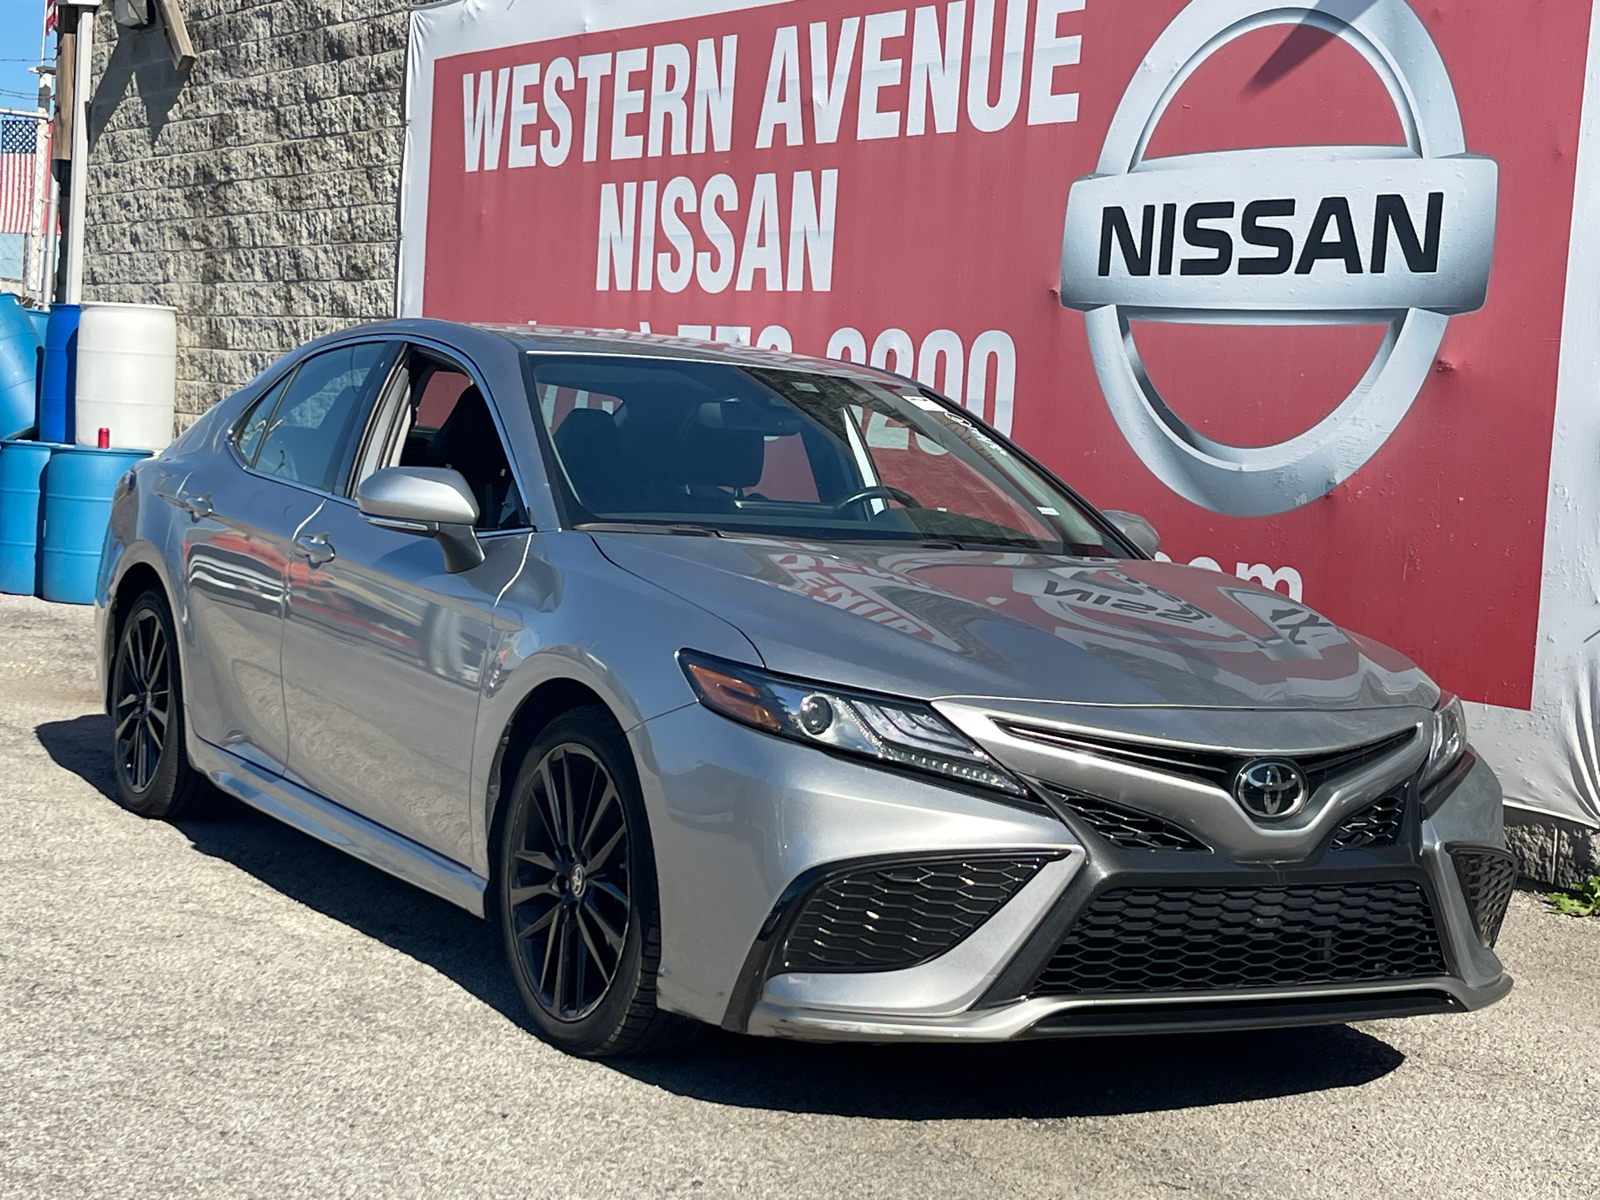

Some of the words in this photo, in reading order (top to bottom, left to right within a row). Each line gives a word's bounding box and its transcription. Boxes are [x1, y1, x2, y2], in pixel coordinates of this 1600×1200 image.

[463, 34, 737, 172] WESTERN
[755, 0, 1085, 149] AVENUE
[596, 169, 838, 293] NISSAN
[1098, 192, 1443, 276] NISSAN
